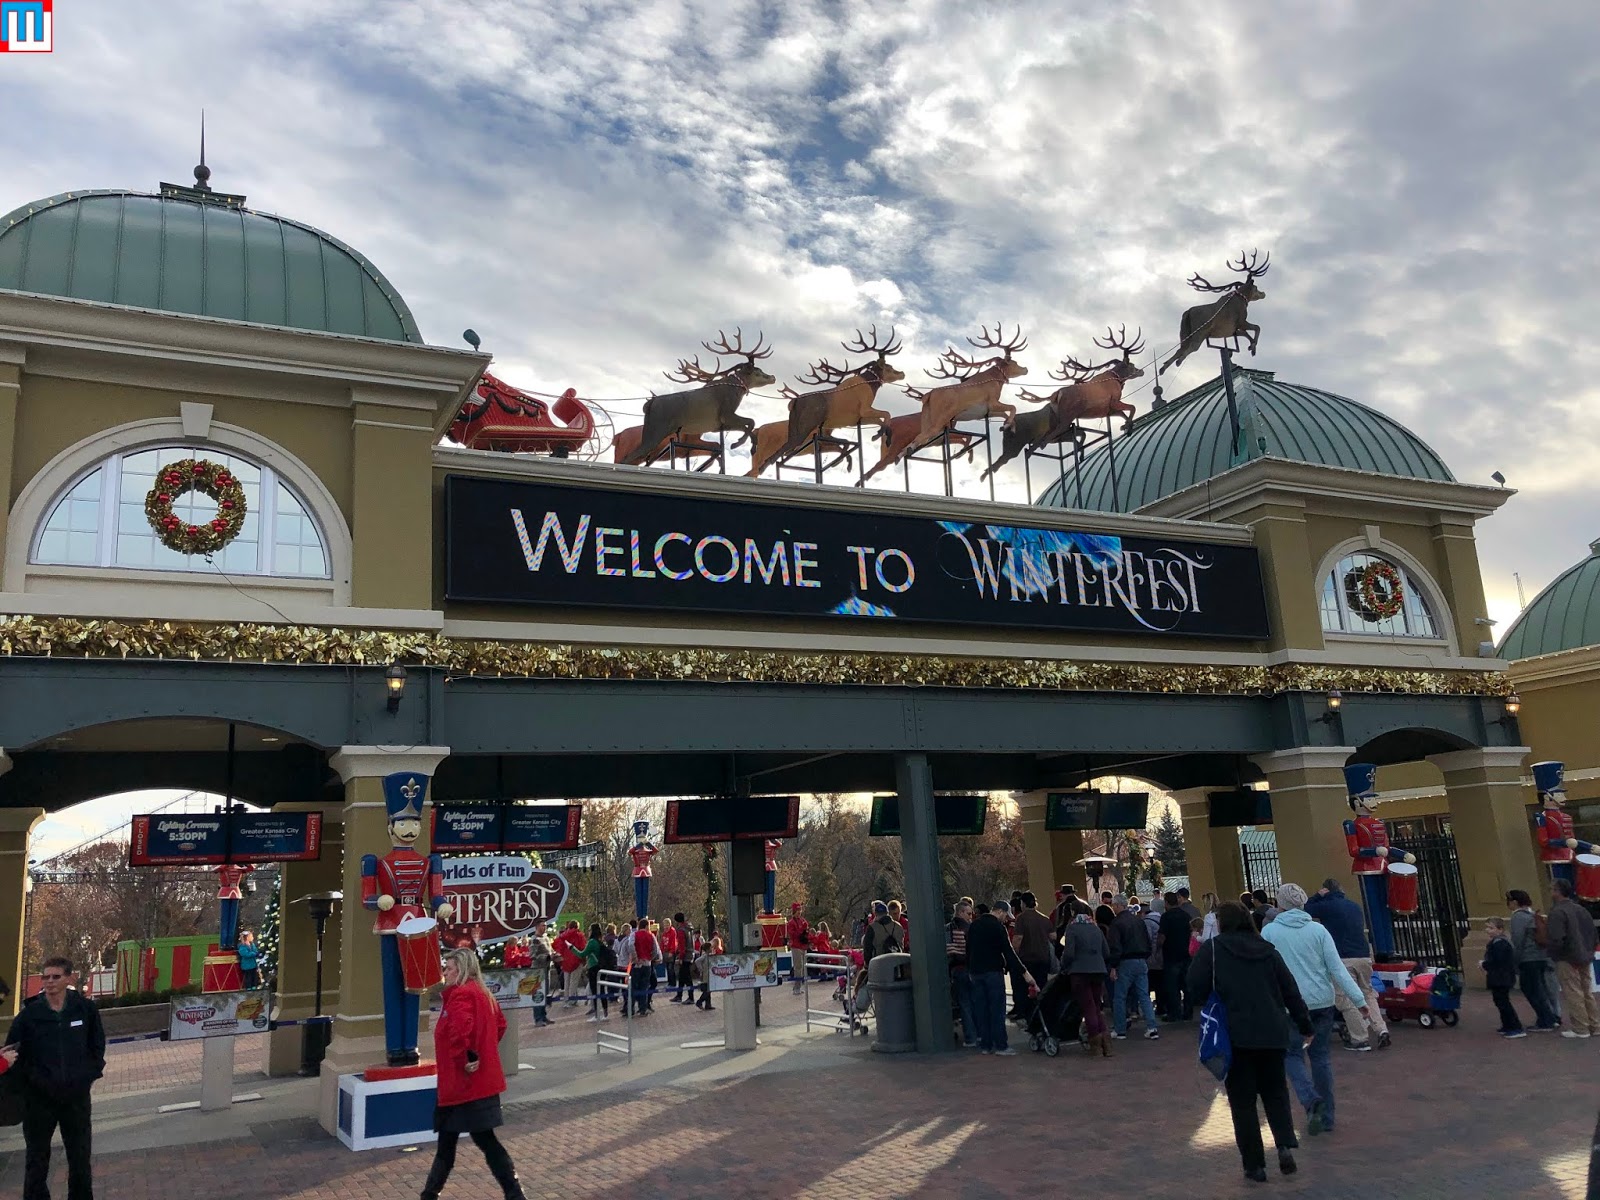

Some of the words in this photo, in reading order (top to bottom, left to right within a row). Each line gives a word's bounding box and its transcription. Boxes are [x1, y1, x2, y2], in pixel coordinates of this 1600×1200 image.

[510, 508, 822, 588] WELCOME
[846, 545, 917, 593] TO
[939, 529, 1213, 631] WINTERFEST
[157, 820, 186, 833] Lighting
[185, 820, 220, 832] Ceremony
[169, 831, 207, 842] 5:30PM
[309, 819, 317, 851] CLOSED
[452, 821, 484, 831] 5:30PM
[136, 822, 144, 856] CLOSED
[442, 864, 475, 879] orlds
[479, 863, 495, 877] of
[498, 863, 525, 877] Fun
[444, 878, 561, 932] TERFEST
